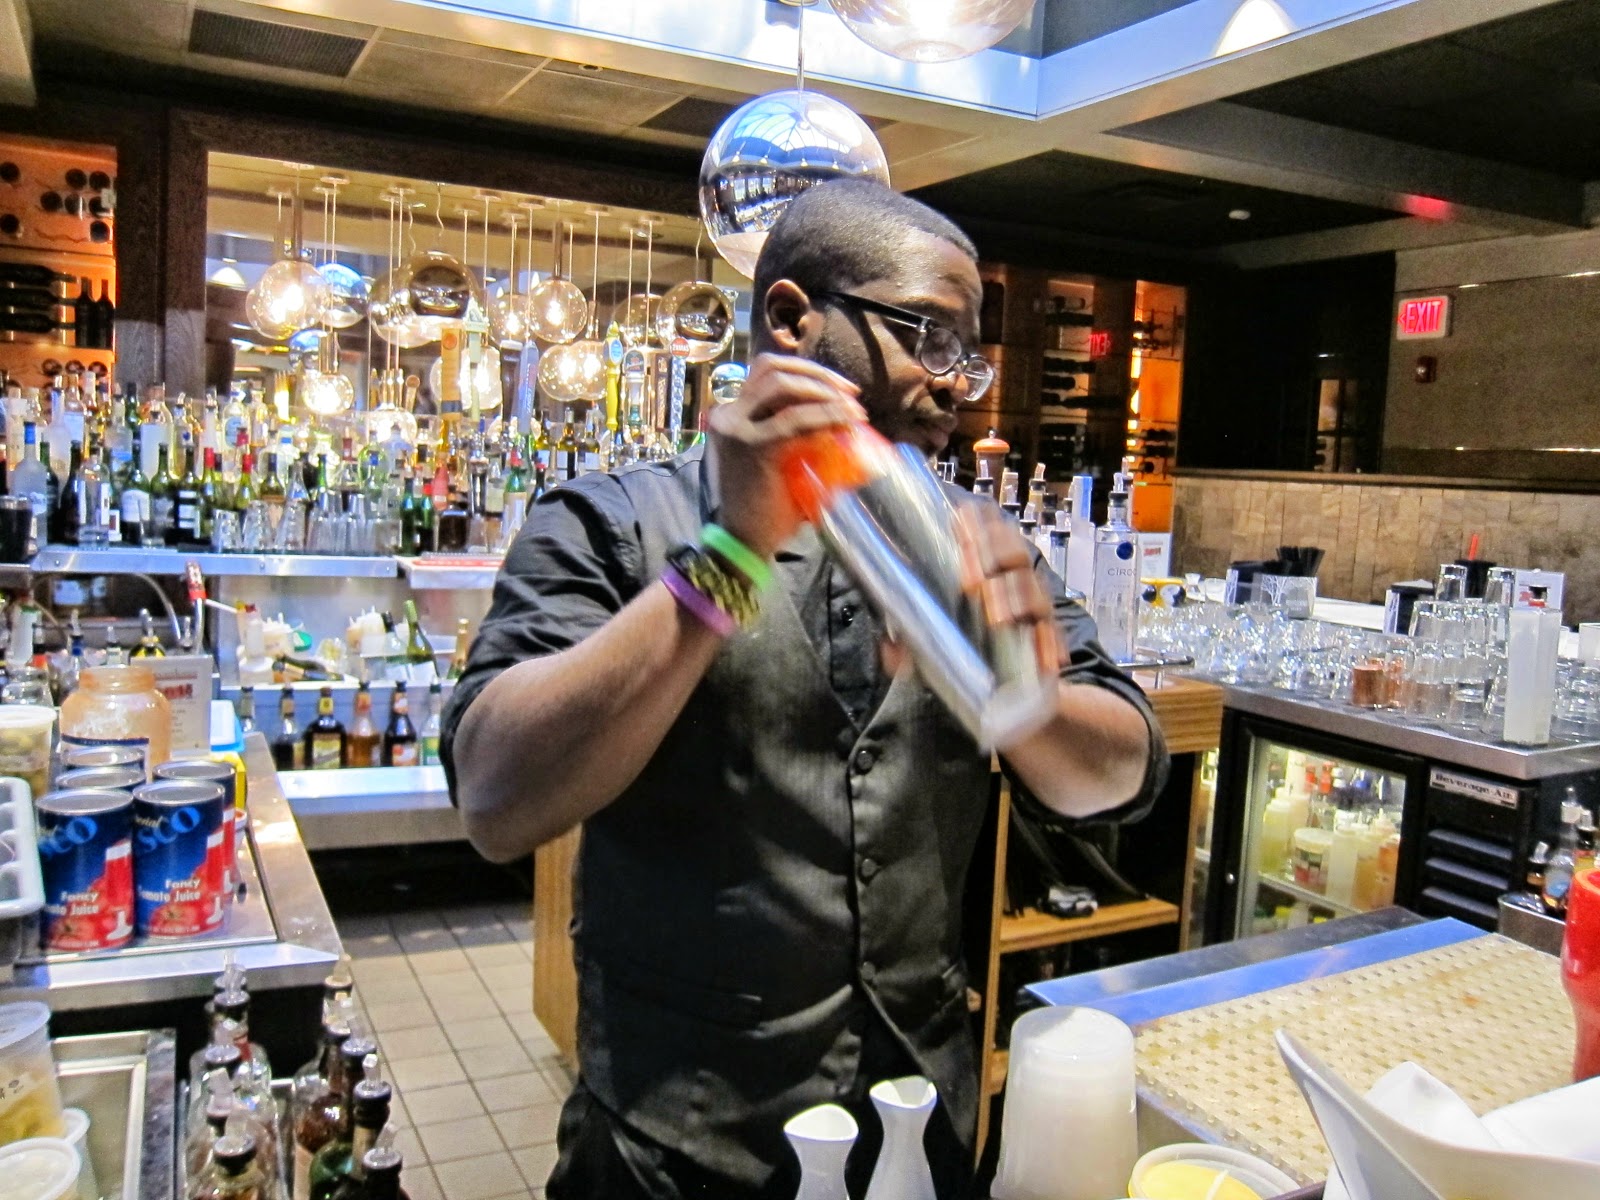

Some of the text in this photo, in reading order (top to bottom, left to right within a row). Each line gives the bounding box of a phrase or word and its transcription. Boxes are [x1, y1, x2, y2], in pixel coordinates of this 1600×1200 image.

[1405, 301, 1441, 333] EXIT
[165, 879, 201, 890] Fancy
[61, 891, 99, 903] Fancy
[174, 889, 201, 902] Juice
[71, 902, 99, 916] Juice
